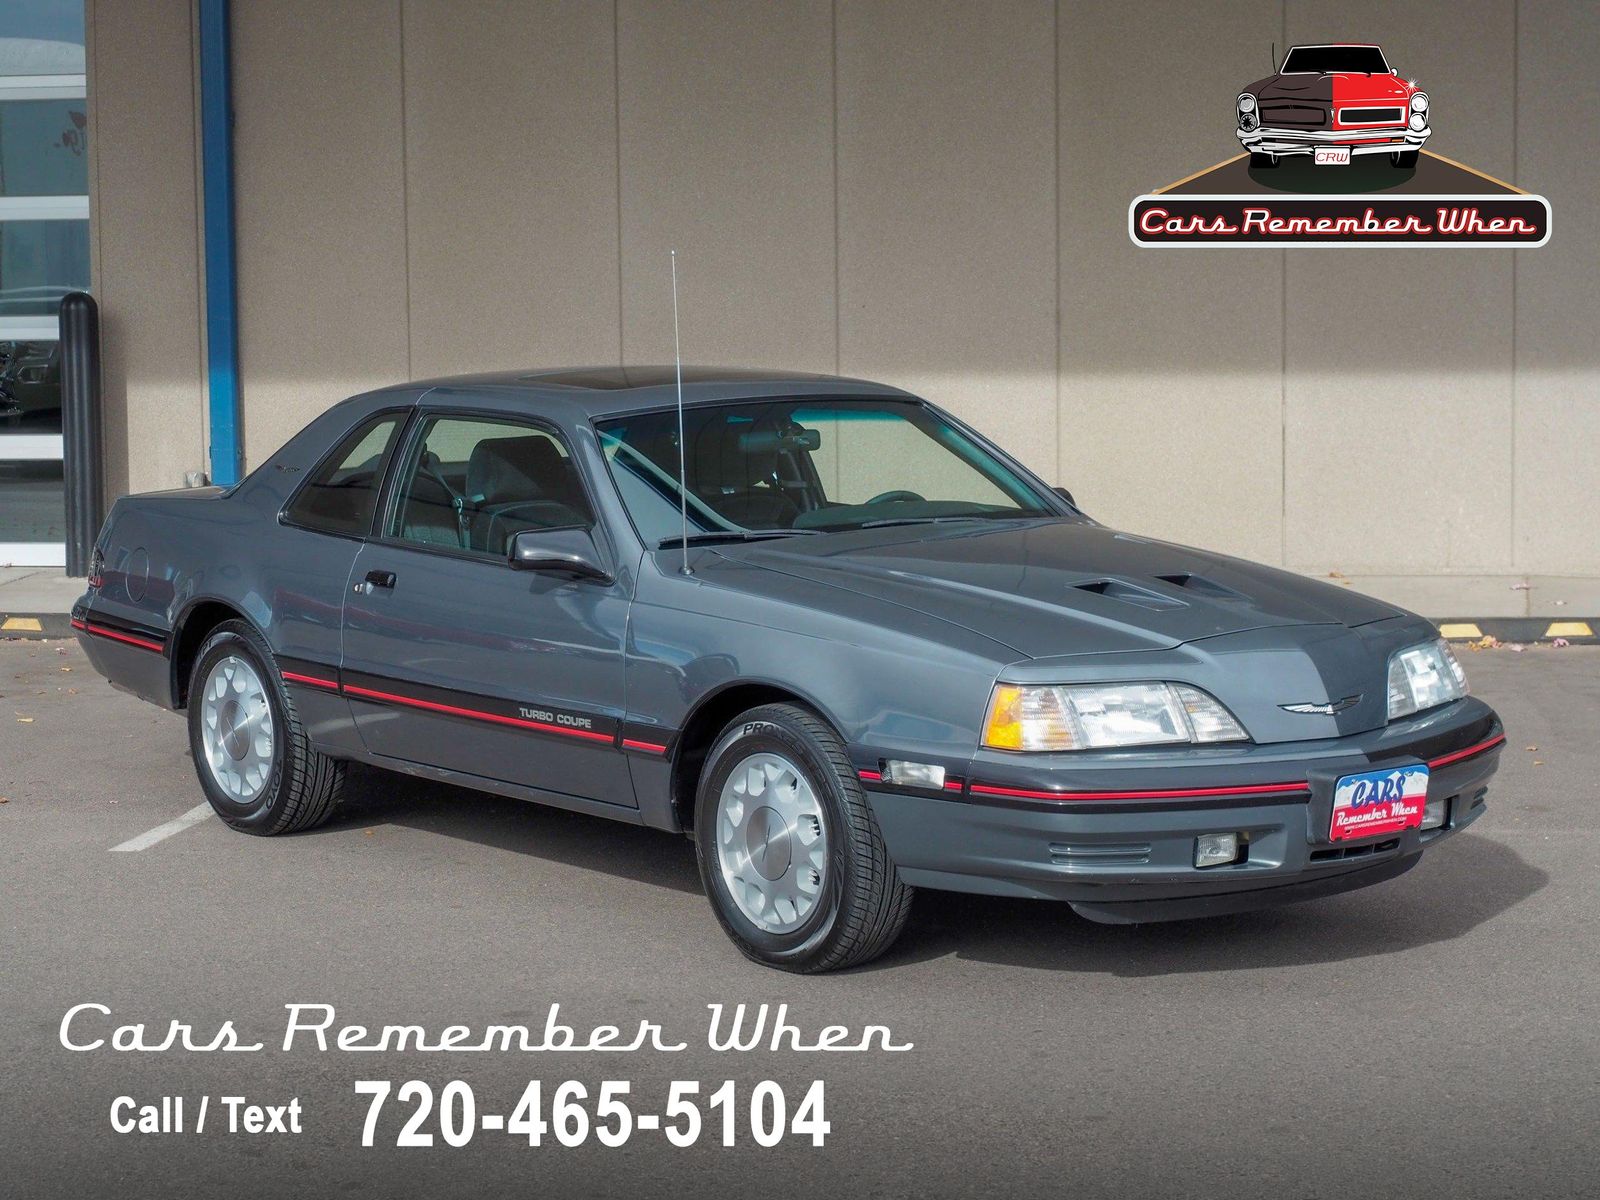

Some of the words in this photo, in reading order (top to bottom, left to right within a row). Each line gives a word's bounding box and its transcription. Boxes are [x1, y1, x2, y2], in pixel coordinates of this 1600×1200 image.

[519, 707, 554, 722] TURBO
[556, 714, 592, 729] COUPE
[1351, 775, 1406, 809] CARS
[1336, 808, 1388, 827] Remember
[1391, 802, 1418, 817] When
